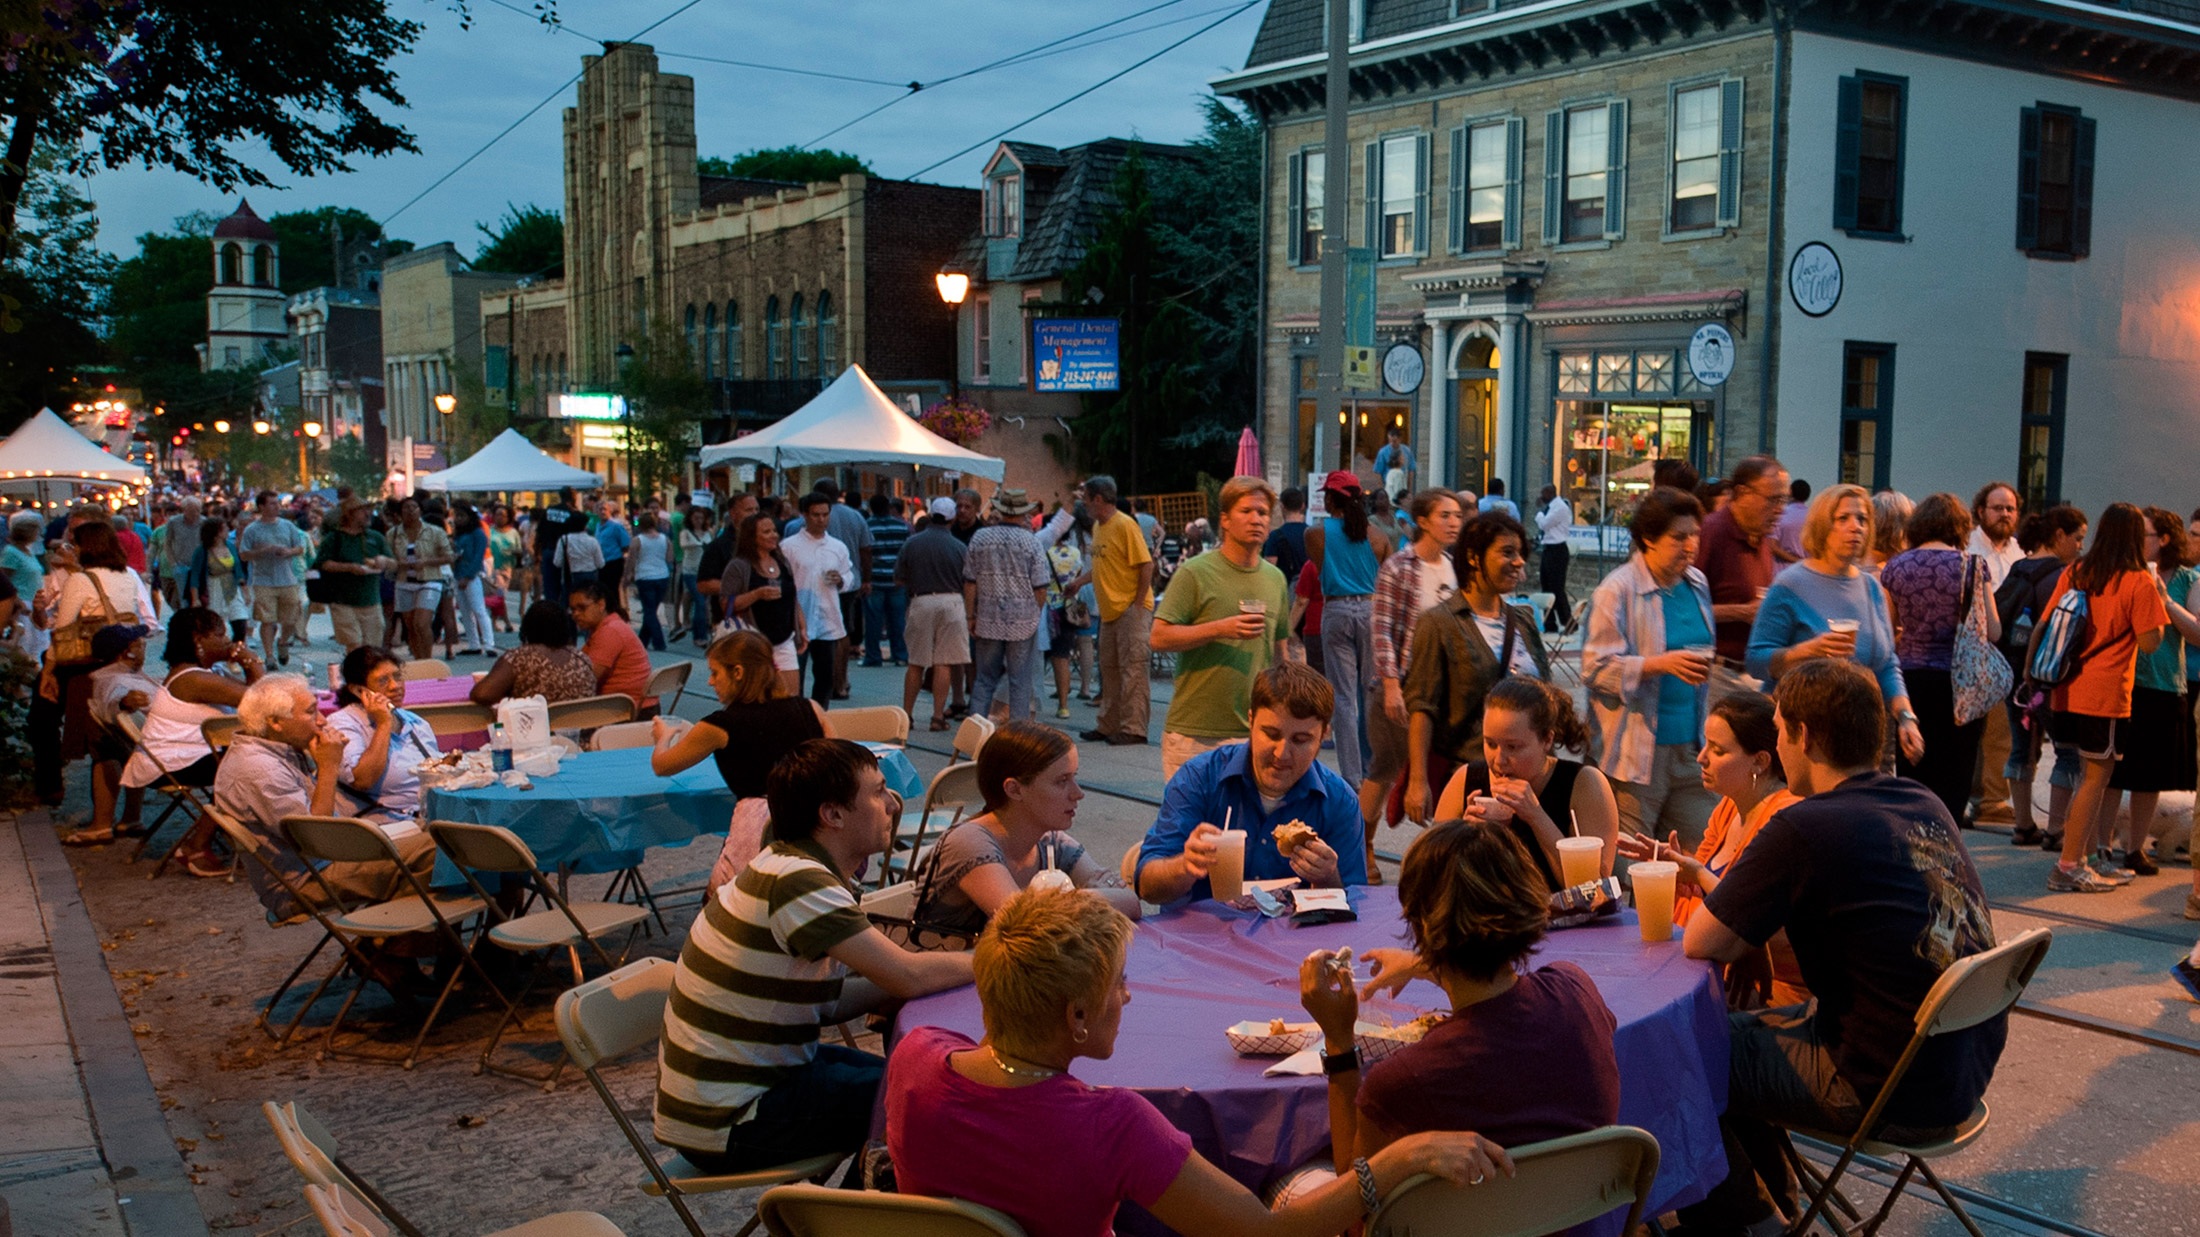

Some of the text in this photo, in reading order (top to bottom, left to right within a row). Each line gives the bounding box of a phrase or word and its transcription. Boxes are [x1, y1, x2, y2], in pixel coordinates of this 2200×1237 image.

[1036, 322, 1115, 333] General Dental
[1042, 335, 1107, 348] Management
